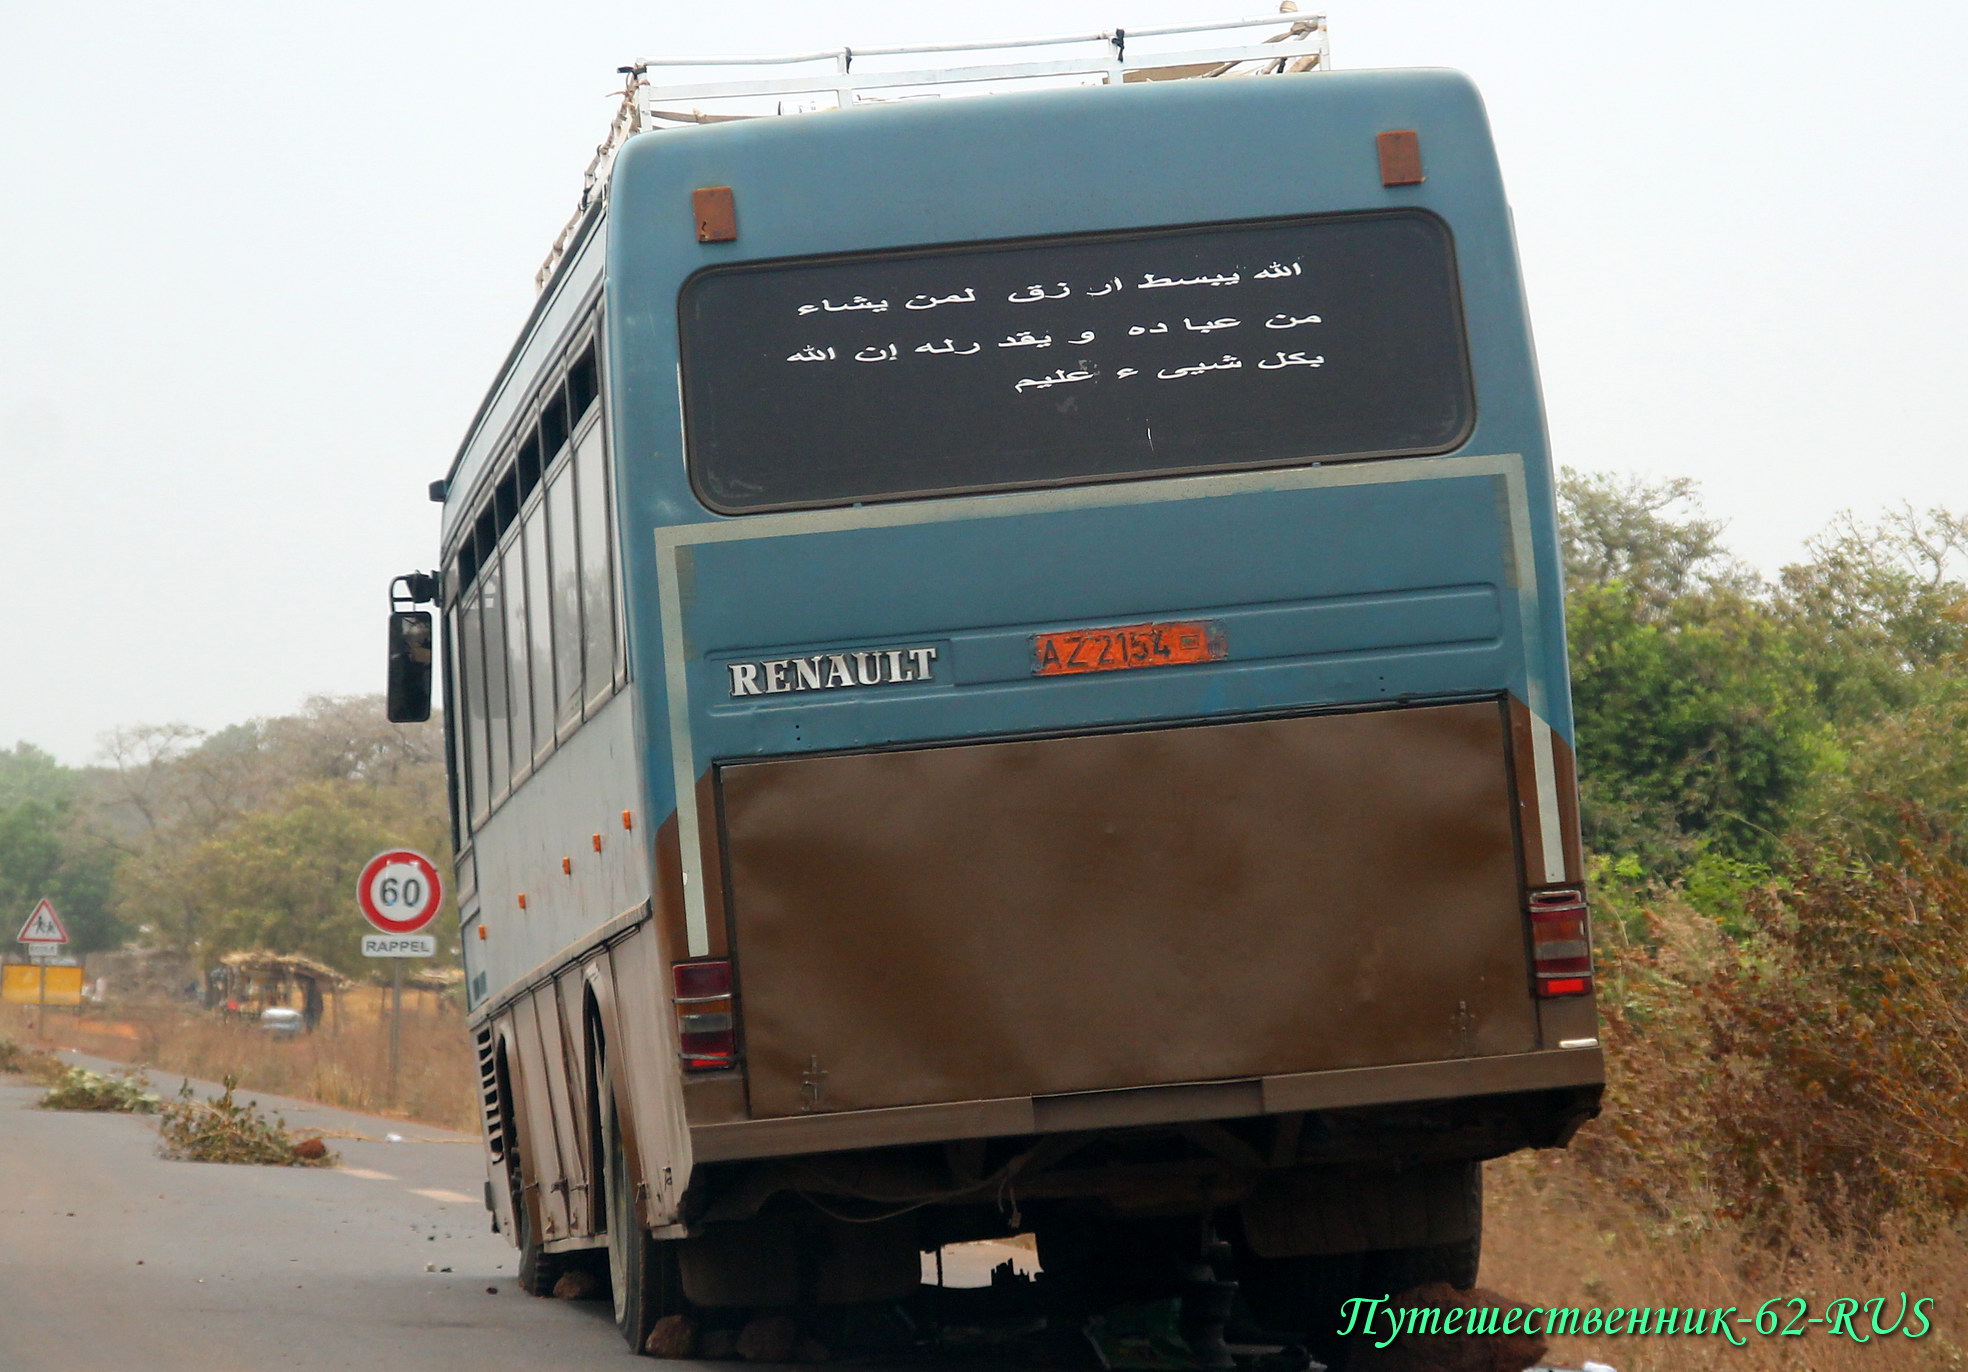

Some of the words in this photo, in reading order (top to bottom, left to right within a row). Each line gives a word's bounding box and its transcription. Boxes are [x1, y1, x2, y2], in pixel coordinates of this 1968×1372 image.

[1254, 262, 1302, 279] الله
[1138, 273, 1240, 289] يبسط
[798, 295, 889, 316] يشاء
[905, 288, 976, 310] لمن
[1265, 314, 1322, 329] من
[1068, 331, 1095, 345] و
[787, 345, 836, 362] الله
[1015, 370, 1094, 394] عليم
[729, 647, 937, 697] RENAULT
[381, 878, 421, 907] 60
[365, 941, 430, 953] RAPPEL
